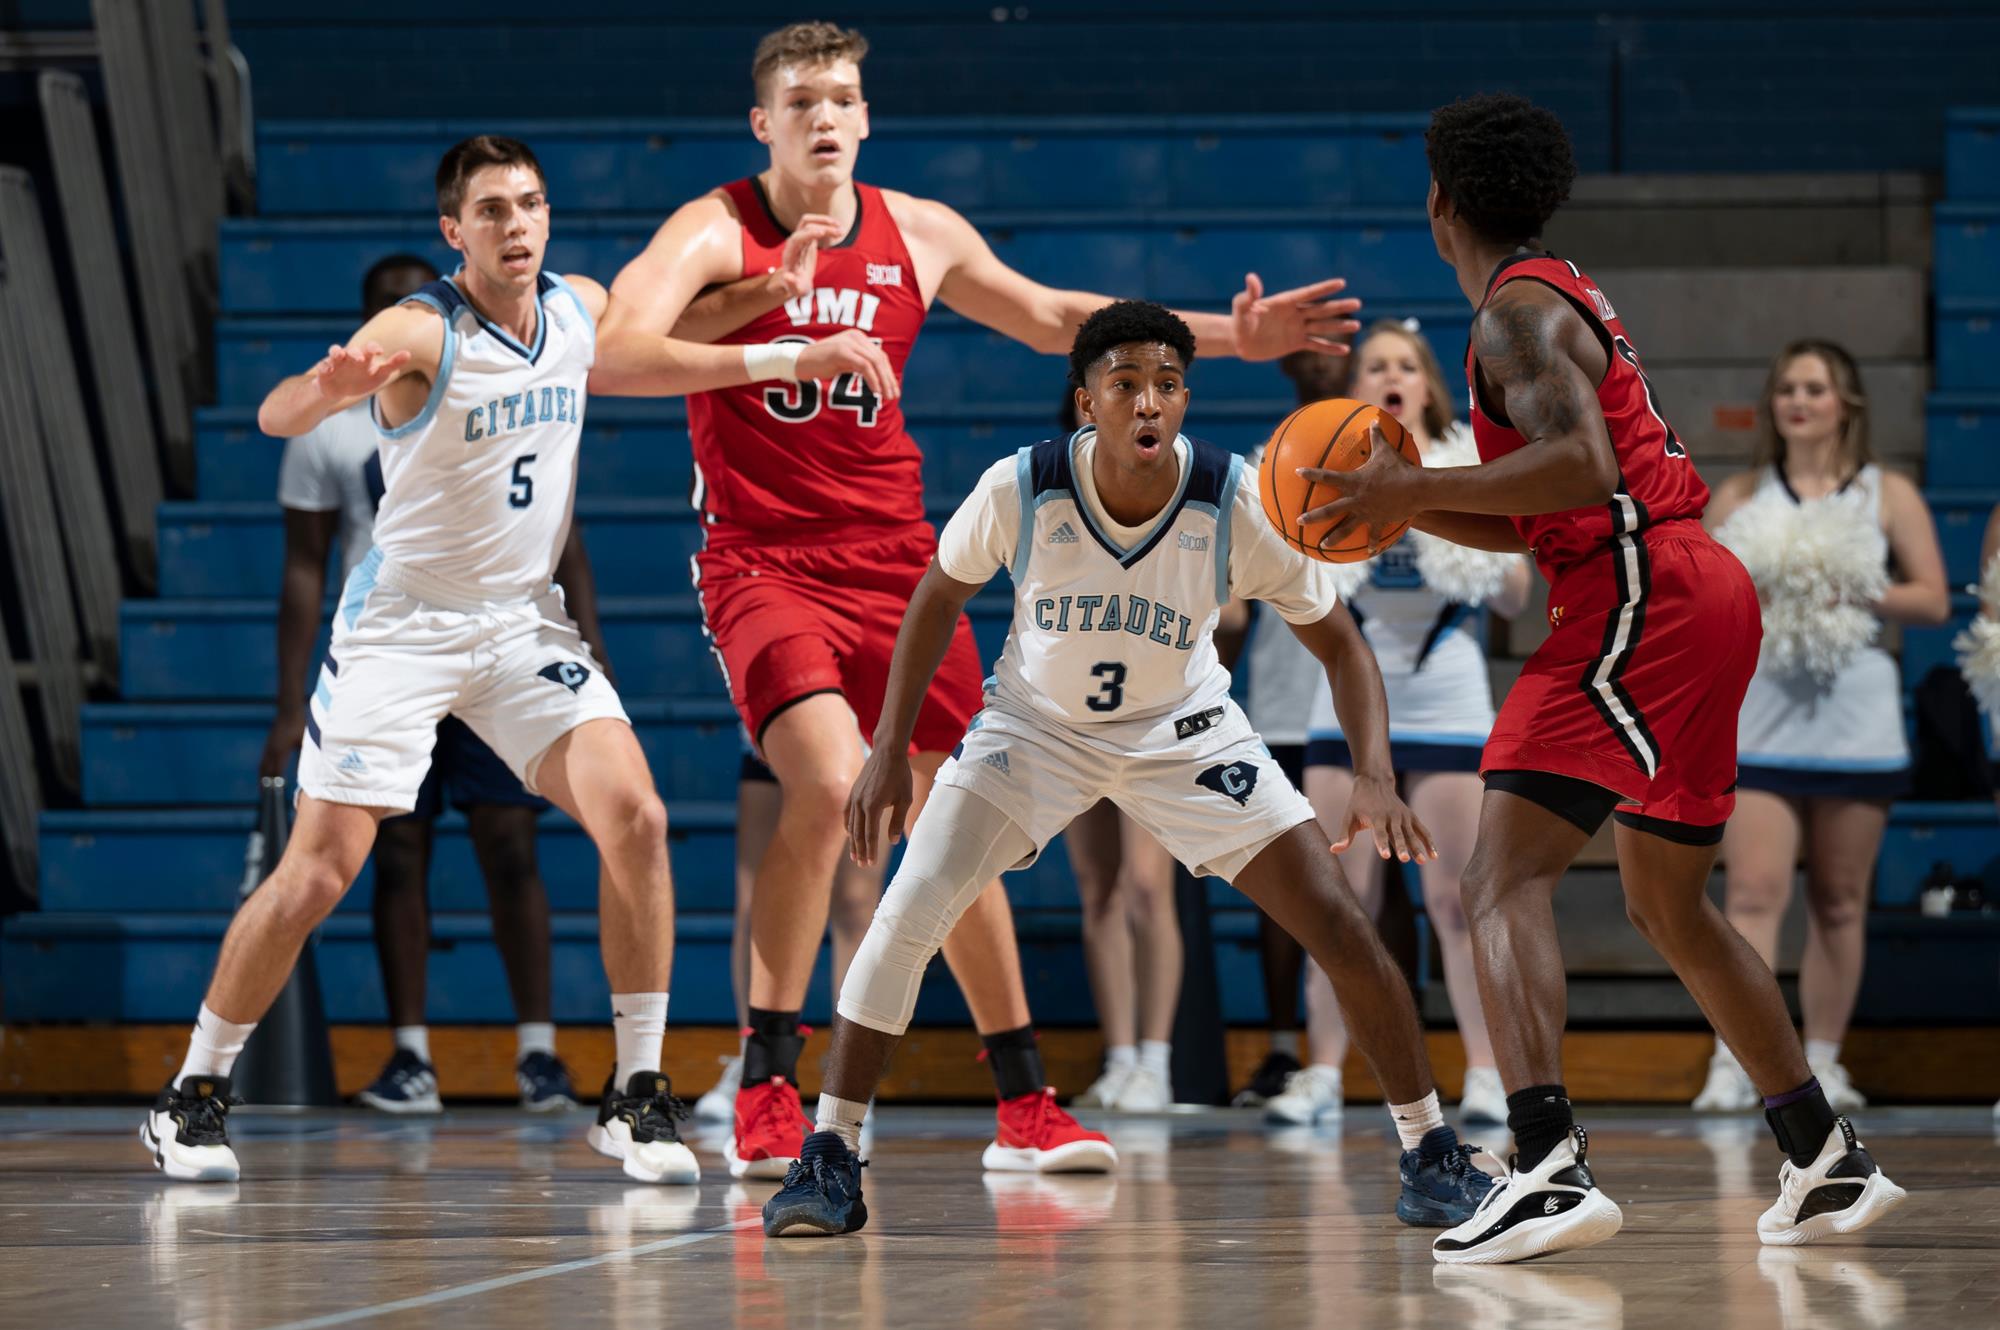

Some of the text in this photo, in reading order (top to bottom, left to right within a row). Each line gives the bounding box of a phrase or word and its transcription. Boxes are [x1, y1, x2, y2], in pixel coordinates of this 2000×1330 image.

[783, 287, 880, 332] VMI
[507, 453, 538, 510] 5
[1177, 530, 1209, 551] SOCON
[1034, 593, 1195, 651] CITADEL
[558, 661, 583, 686] C
[1085, 661, 1128, 713] 3
[1221, 766, 1248, 795] C
